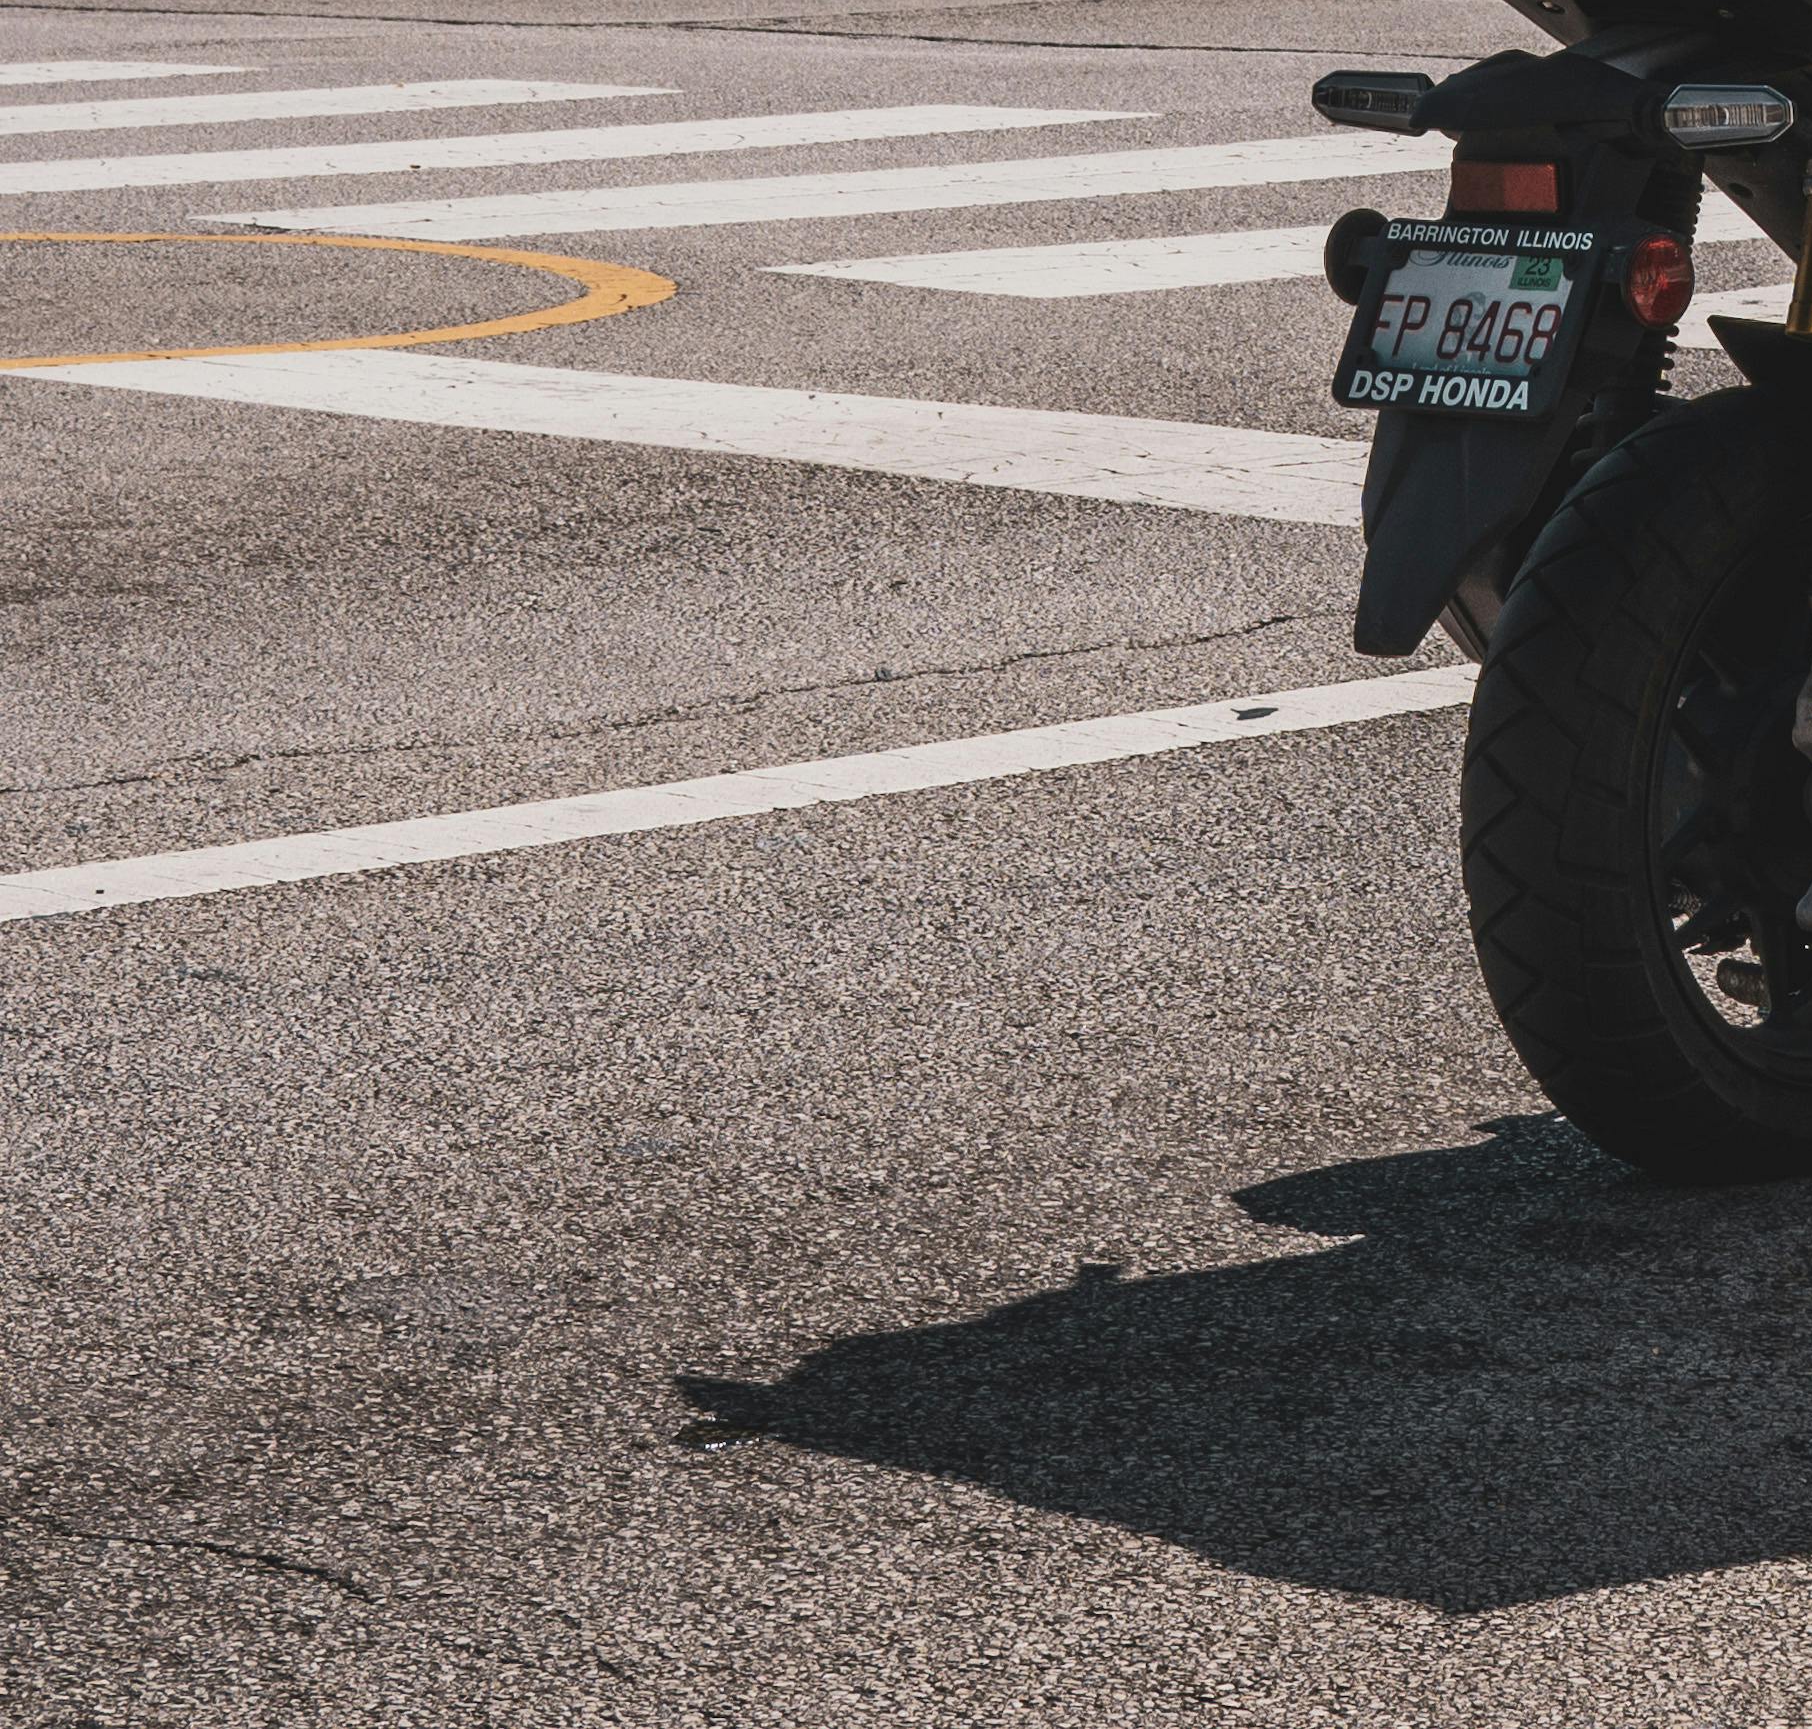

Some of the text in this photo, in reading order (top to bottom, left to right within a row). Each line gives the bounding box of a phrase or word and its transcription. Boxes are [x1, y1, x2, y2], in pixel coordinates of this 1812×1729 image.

[1387, 223, 1594, 251] BARRINGTON ILLINOIS
[1526, 256, 1550, 276] 23
[1518, 278, 1551, 288] ILLINOIS
[1436, 299, 1562, 365] 8468
[1349, 370, 1528, 410] DSP HONDA
